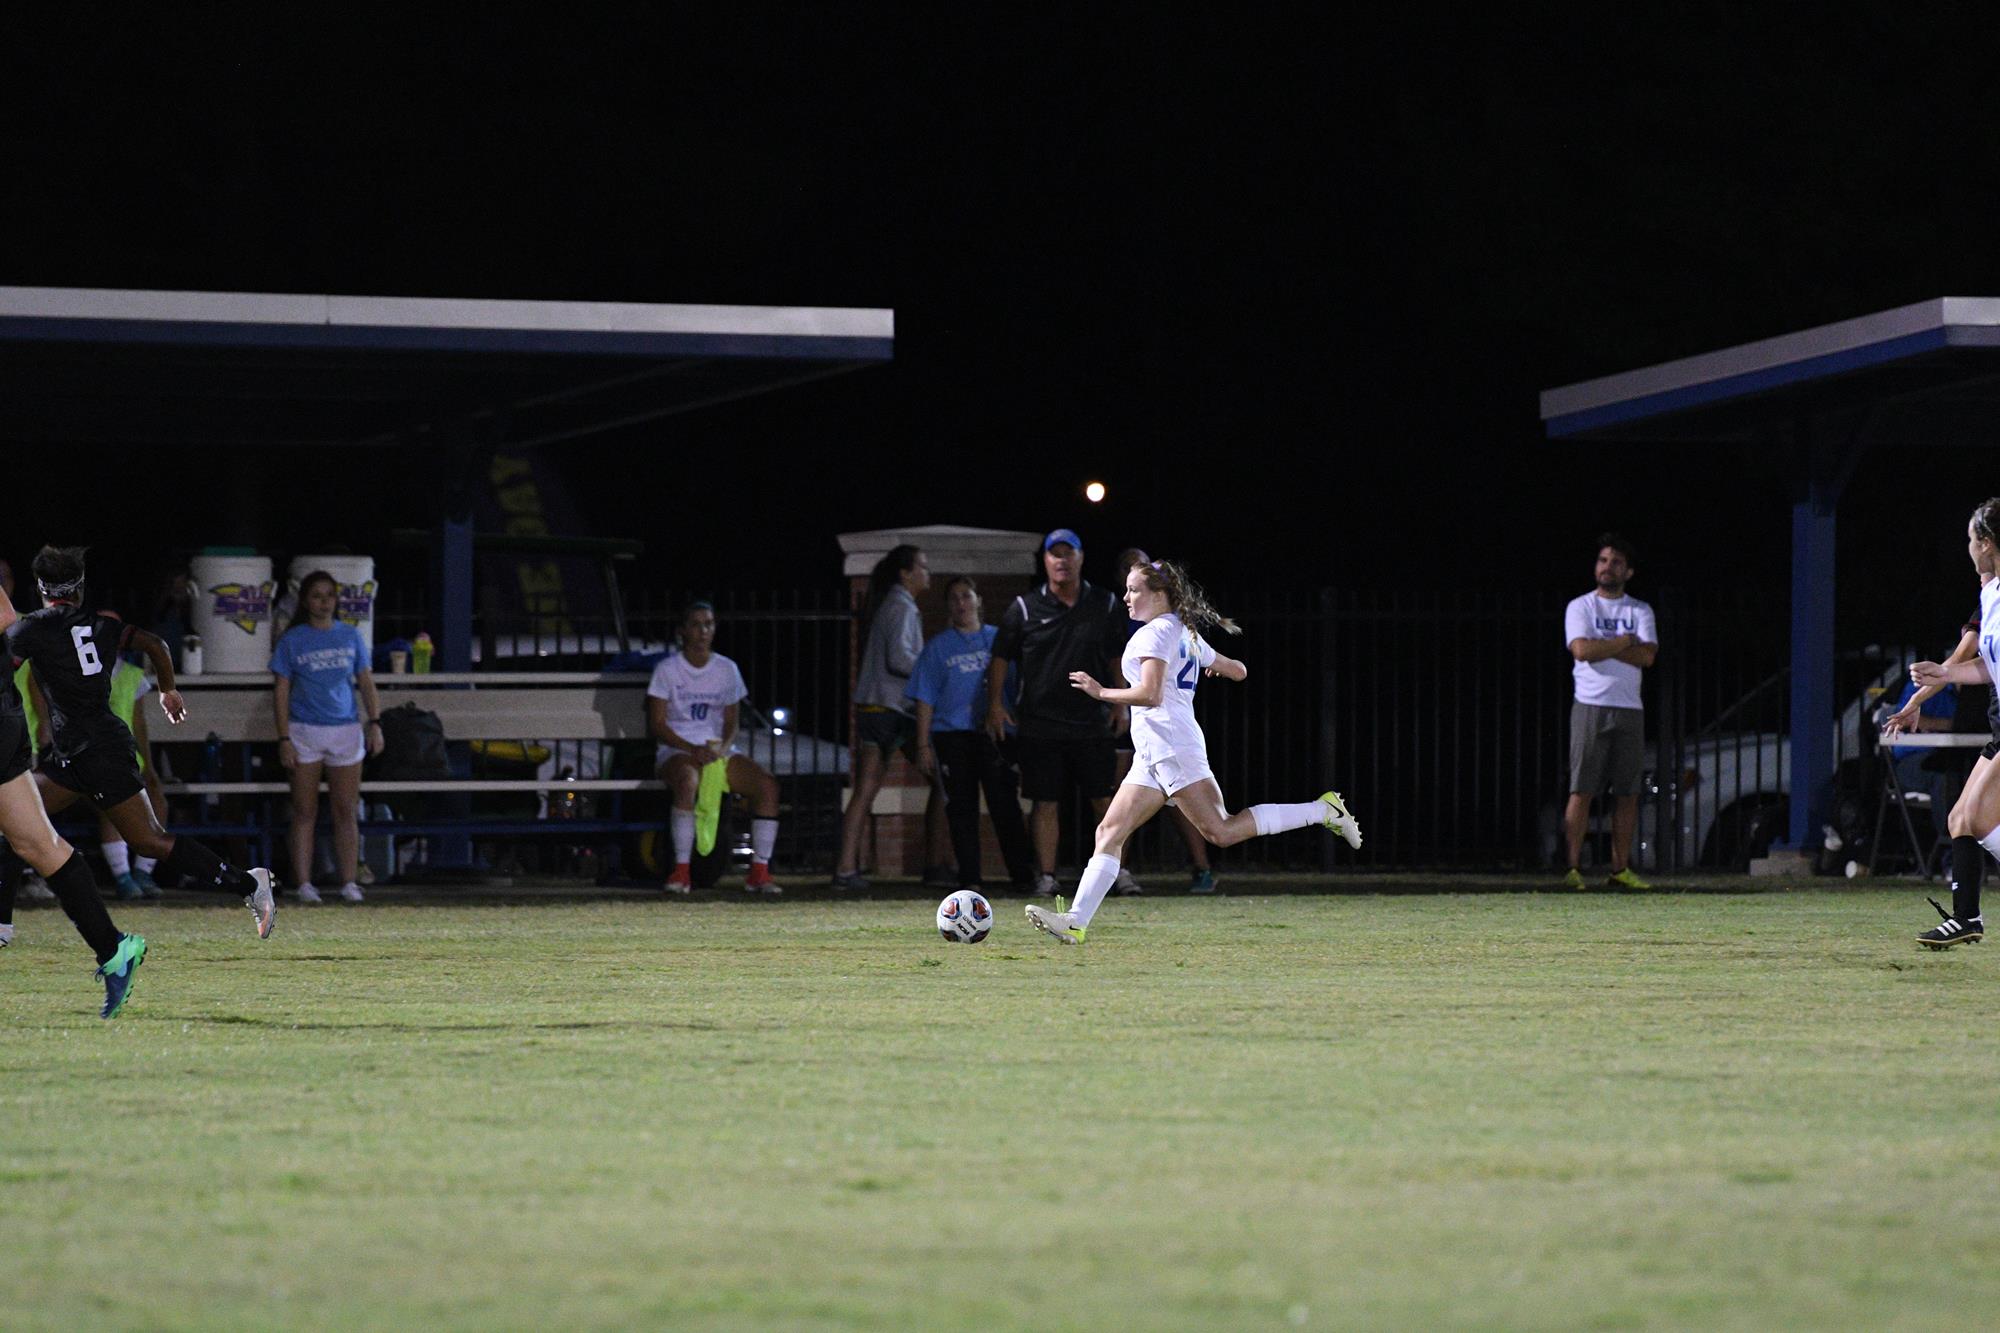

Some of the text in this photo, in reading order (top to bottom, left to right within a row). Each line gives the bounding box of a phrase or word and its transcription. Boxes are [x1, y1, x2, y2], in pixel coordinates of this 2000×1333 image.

[70, 625, 103, 676] 6
[1983, 634, 1997, 663] 7
[691, 703, 709, 720] 10
